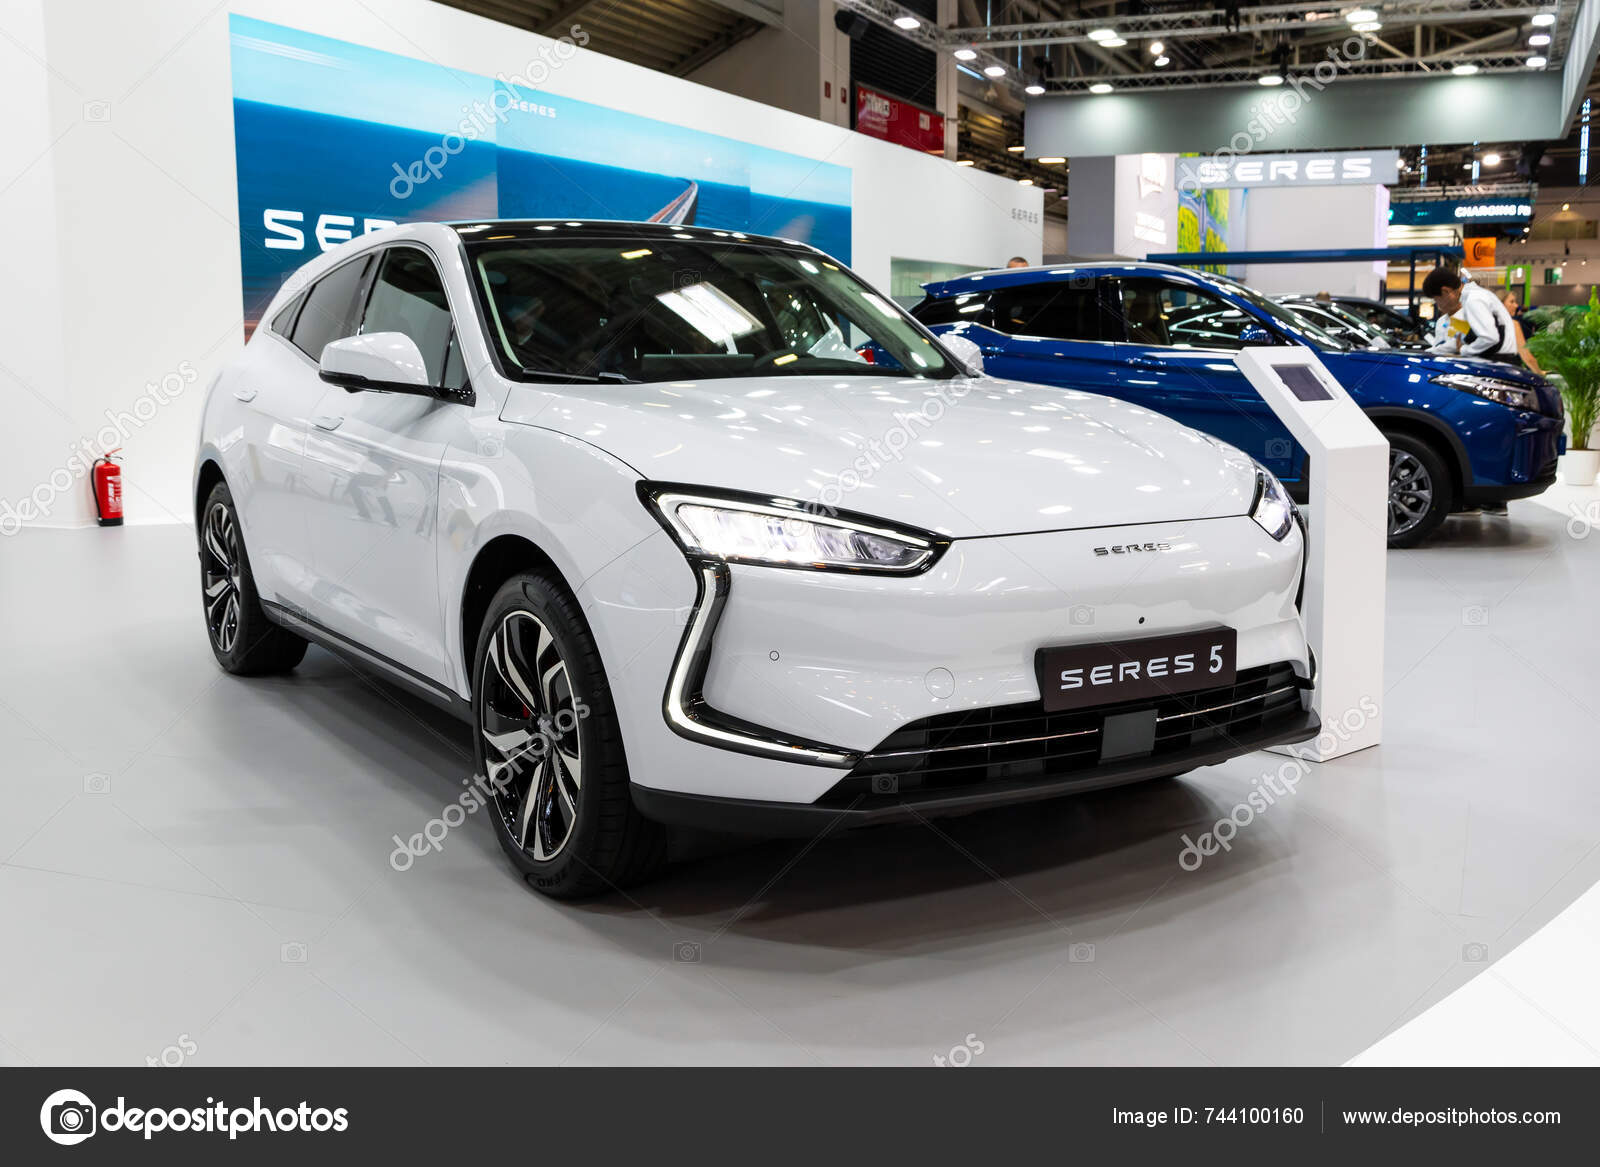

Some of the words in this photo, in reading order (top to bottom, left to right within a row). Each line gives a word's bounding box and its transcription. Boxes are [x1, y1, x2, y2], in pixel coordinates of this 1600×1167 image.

[511, 100, 557, 119] SERES
[1200, 157, 1372, 183] SERES
[1011, 208, 1039, 225] SERES
[1094, 542, 1172, 557] SERES
[1060, 653, 1195, 690] SERES
[1208, 644, 1223, 674] 5
